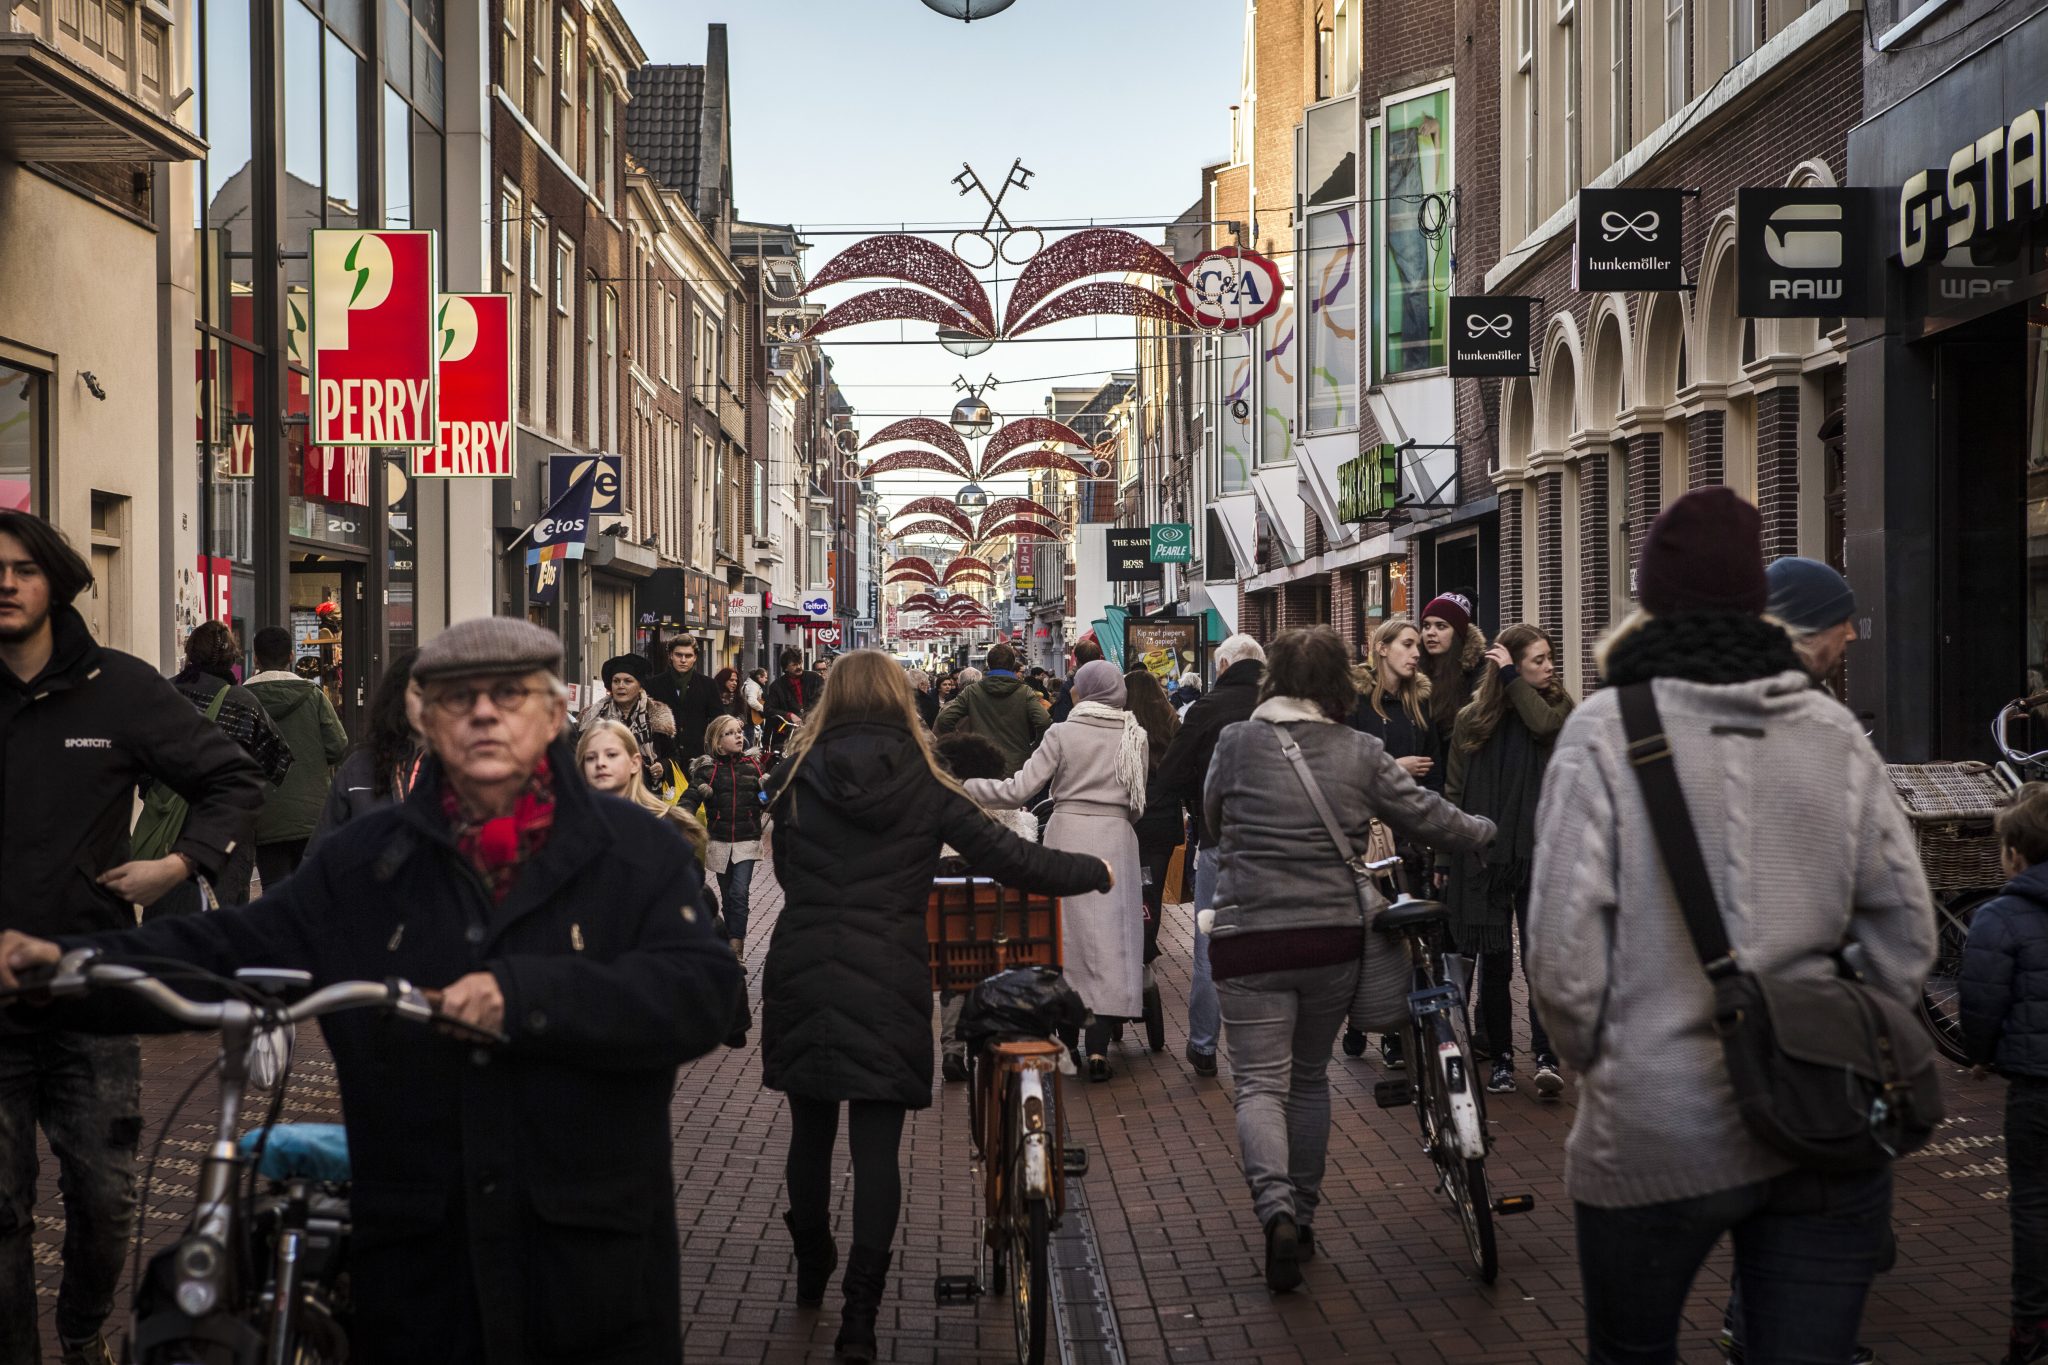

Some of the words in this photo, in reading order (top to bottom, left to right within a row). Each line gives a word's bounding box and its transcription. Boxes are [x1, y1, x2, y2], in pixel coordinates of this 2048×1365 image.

[1901, 102, 2048, 268] G-STA
[1589, 257, 1671, 270] hunkemöller
[1196, 270, 1264, 305] C&A
[1769, 279, 1842, 299] RAW
[1457, 349, 1522, 361] hunkemöller
[320, 378, 430, 441] PERRY
[541, 519, 584, 537] etos
[1112, 539, 1128, 547] THE
[1155, 543, 1187, 556] PEARLE
[804, 602, 828, 610] Telfort
[65, 738, 112, 749] SPORTCITY
